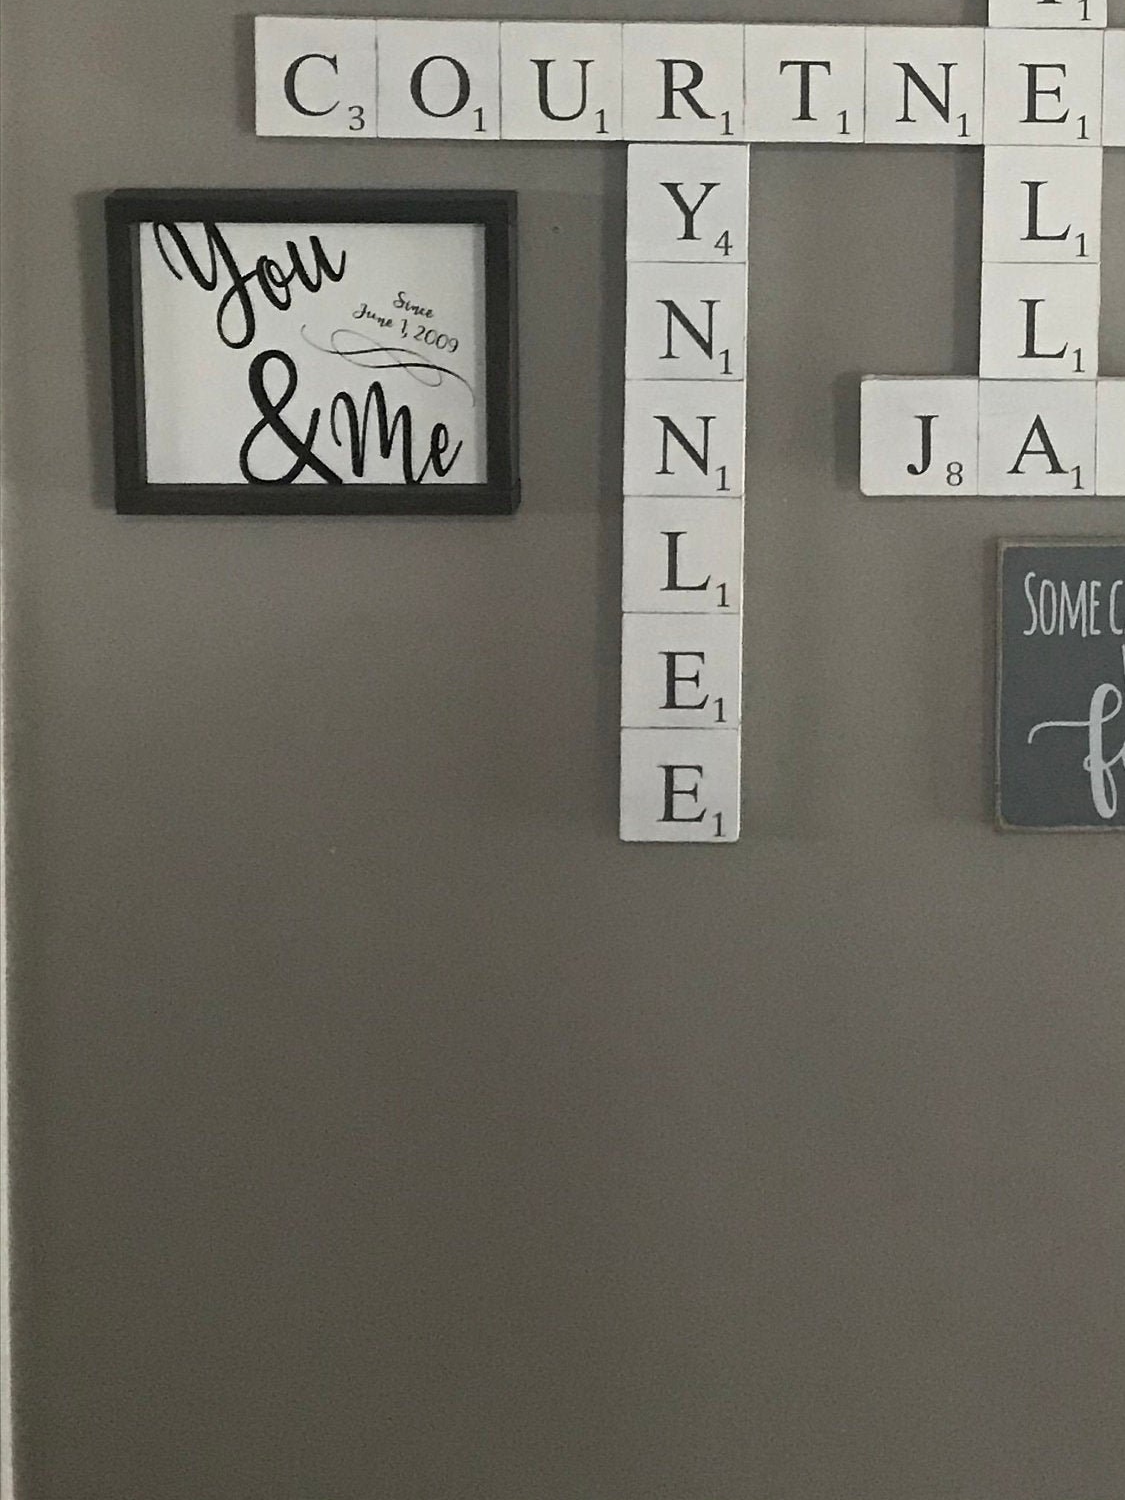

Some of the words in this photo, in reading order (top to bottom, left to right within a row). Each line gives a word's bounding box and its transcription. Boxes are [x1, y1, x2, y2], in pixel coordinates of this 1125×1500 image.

[348, 105, 366, 131] 3
[473, 106, 486, 132] 1
[595, 108, 609, 134] 1
[721, 110, 734, 136] 1
[837, 109, 850, 135] 1
[957, 112, 969, 138] 1
[1076, 114, 1090, 141] 1
[713, 230, 733, 257] 4
[1075, 232, 1089, 258] 1
[153, 222, 346, 349] You
[392, 291, 434, 318] Since
[352, 303, 393, 328] June
[413, 325, 460, 353] 2009
[719, 348, 733, 375] 1
[1073, 347, 1085, 373] 1
[239, 350, 344, 485] &
[330, 381, 463, 484] Me
[653, 58, 721, 823] RYNNLEE
[716, 465, 731, 492] 1
[946, 461, 963, 487] 8
[1071, 465, 1084, 490] 1
[716, 582, 730, 608] 1
[1023, 571, 1102, 637] SOME
[714, 697, 727, 723] 1
[713, 811, 727, 838] 1
